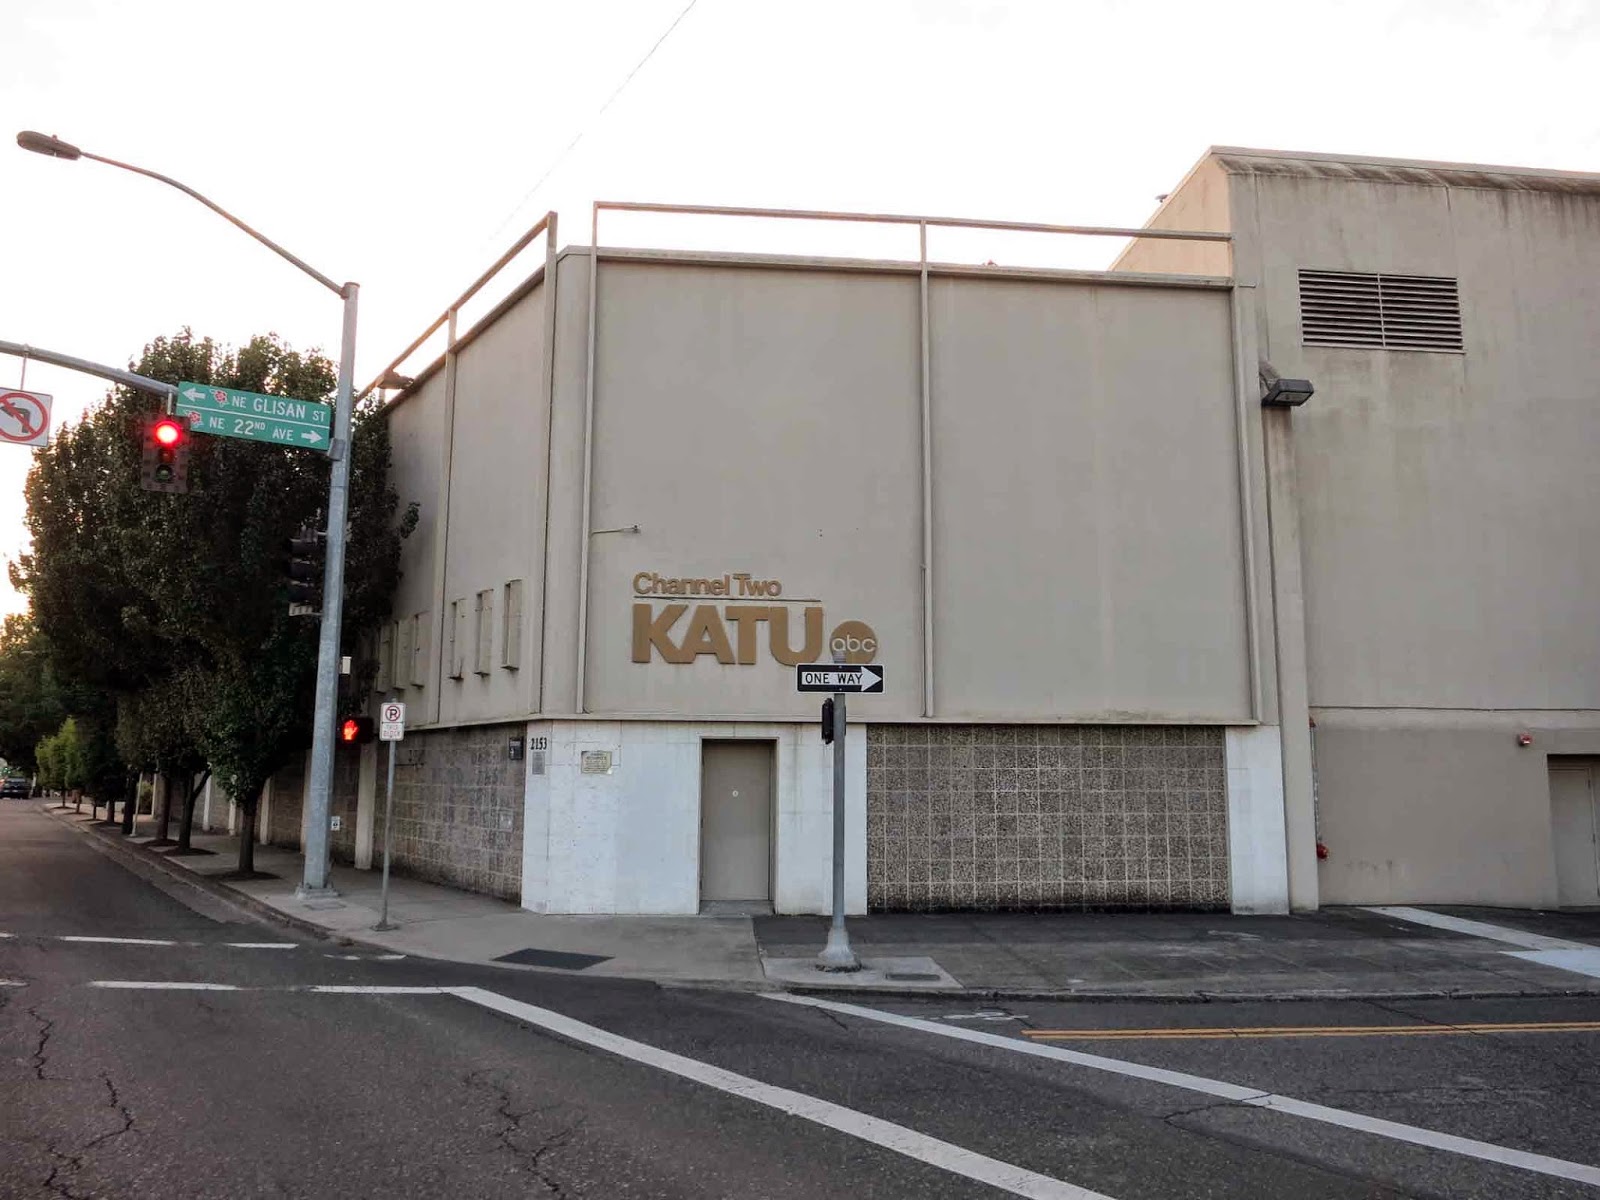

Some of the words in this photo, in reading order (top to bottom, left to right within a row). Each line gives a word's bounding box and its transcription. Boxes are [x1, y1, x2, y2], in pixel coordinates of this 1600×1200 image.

[232, 395, 246, 409] NE
[253, 397, 306, 419] GLISAN
[312, 410, 326, 422] ST
[209, 416, 225, 430] NE
[272, 426, 294, 441] AVE
[632, 571, 731, 596] Channel
[733, 573, 783, 597] Two
[631, 603, 823, 667] KATU
[831, 634, 878, 653] abc
[805, 672, 831, 685] ONE
[837, 672, 863, 685] WAY
[530, 737, 548, 750] 2153
